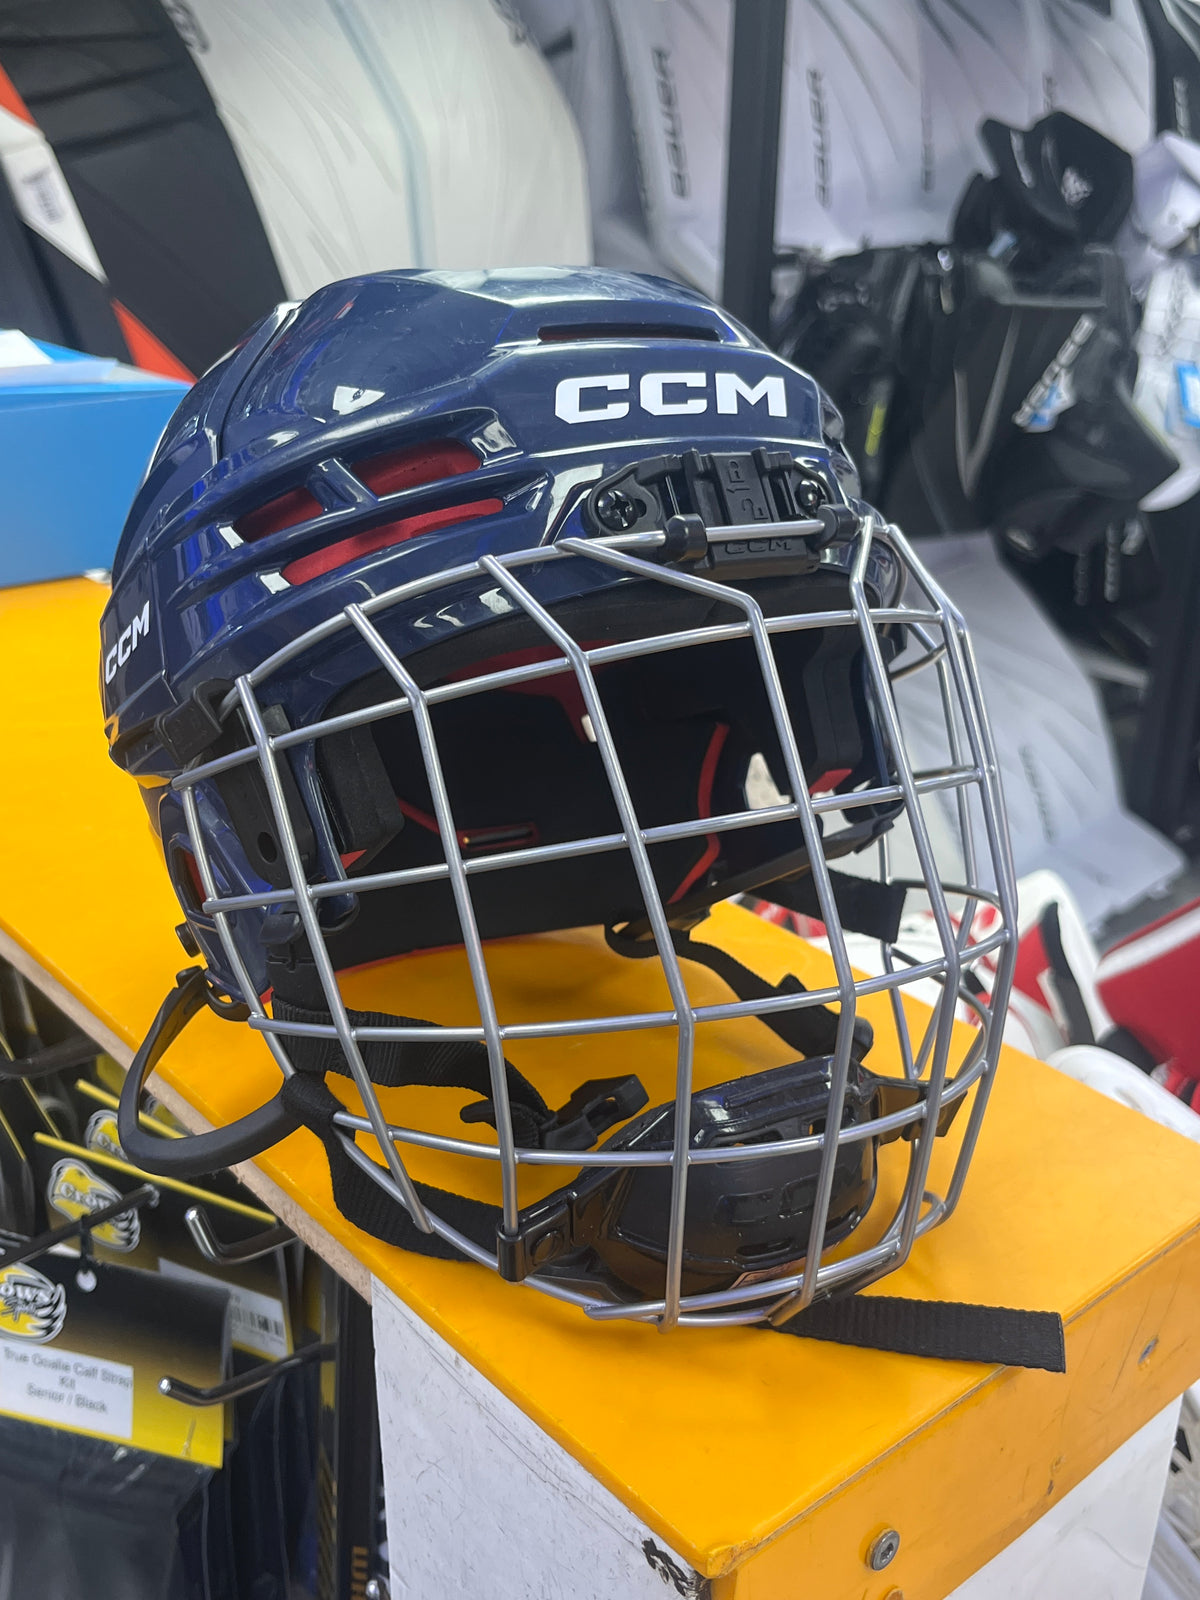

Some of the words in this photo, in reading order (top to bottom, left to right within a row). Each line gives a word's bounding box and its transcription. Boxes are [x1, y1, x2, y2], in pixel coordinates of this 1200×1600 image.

[555, 372, 787, 424] CCM
[105, 600, 150, 685] CCM
[4, 1346, 29, 1361] True
